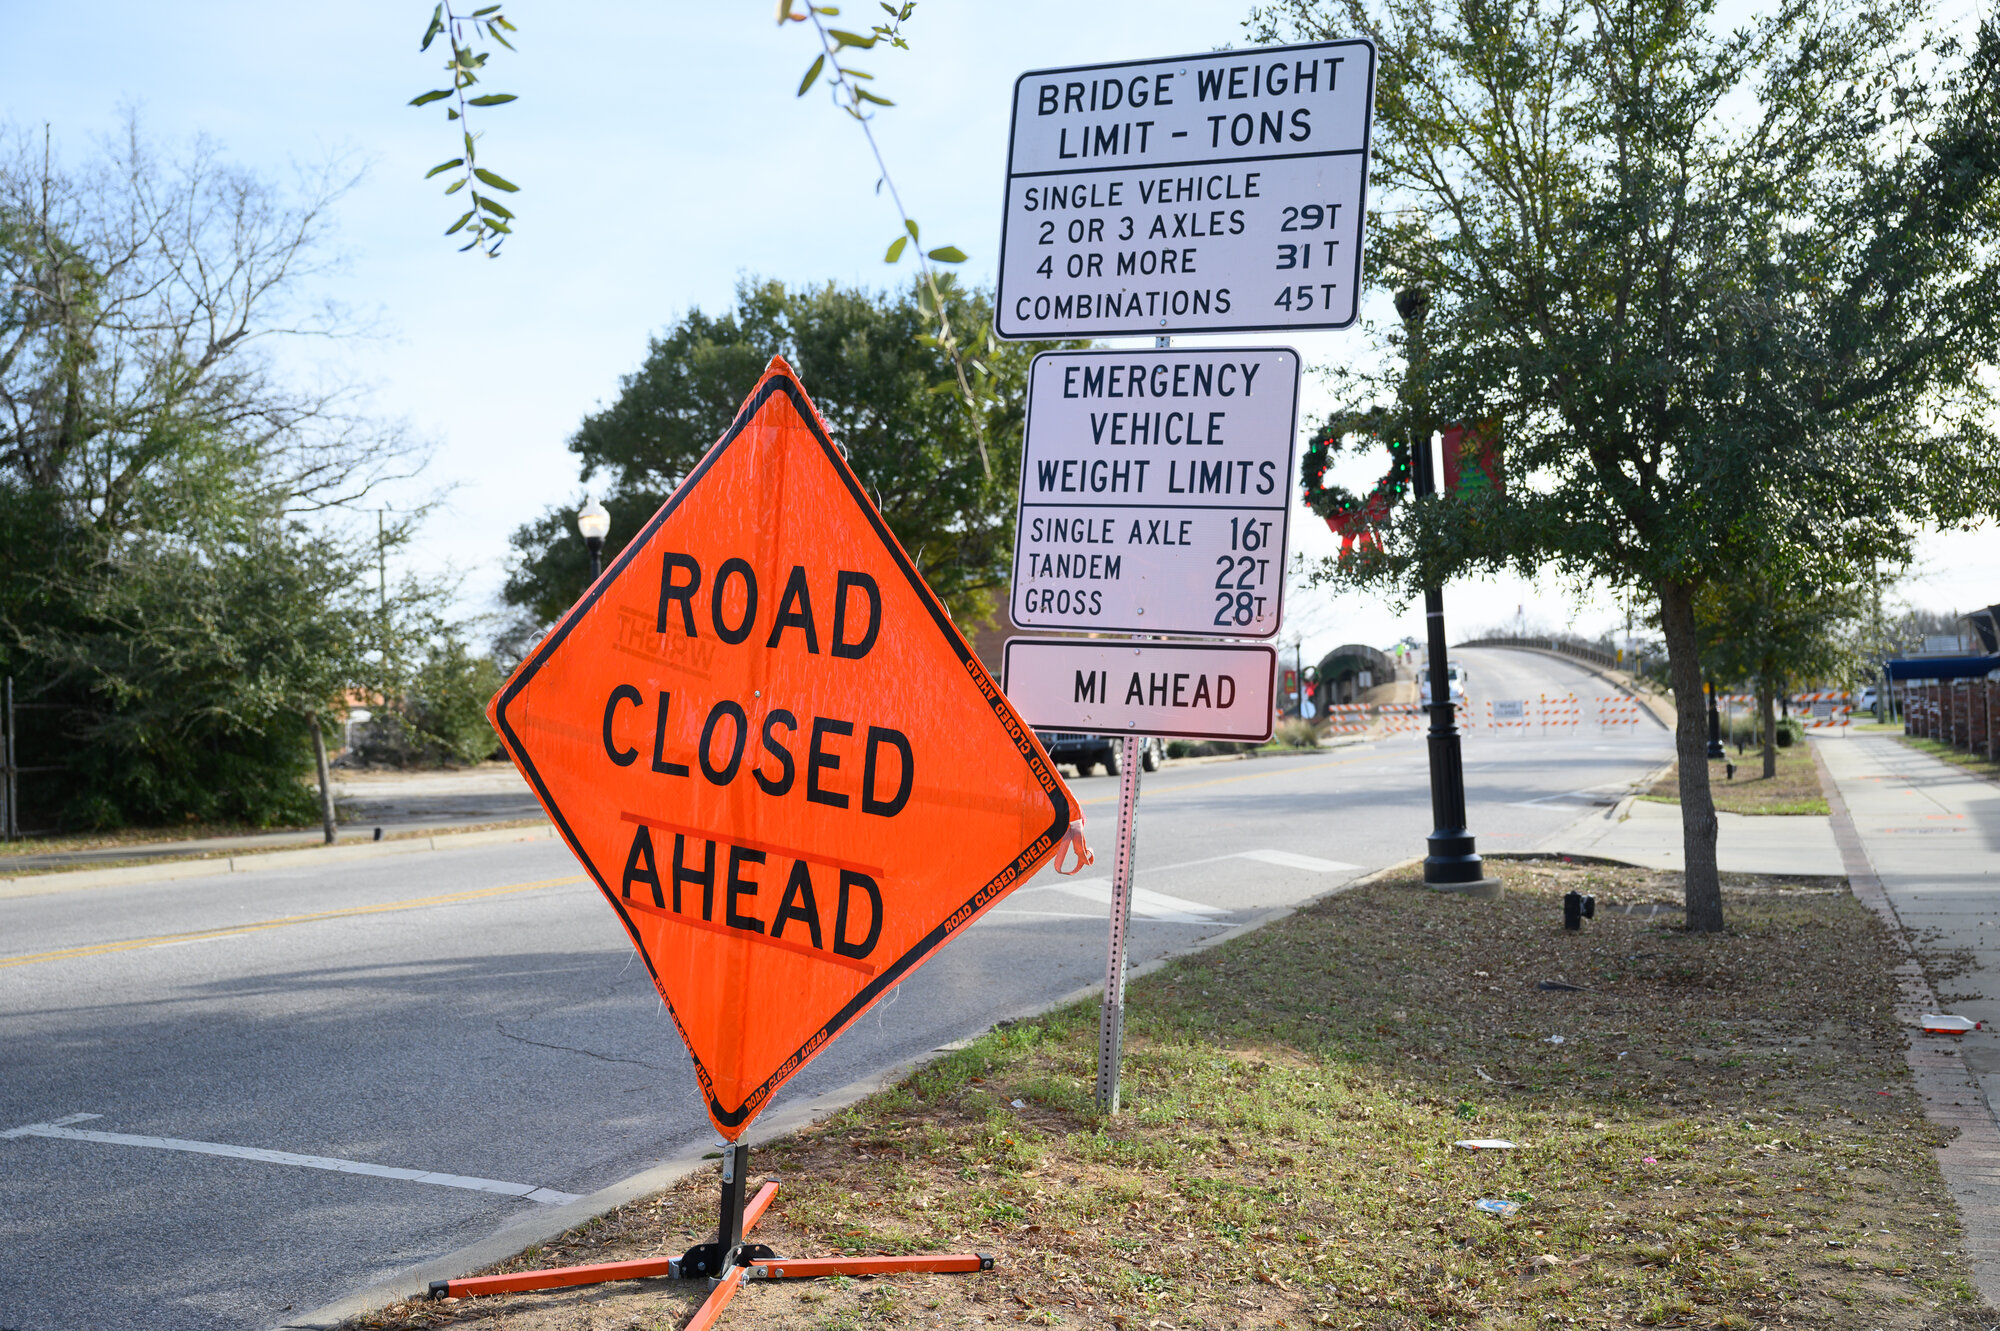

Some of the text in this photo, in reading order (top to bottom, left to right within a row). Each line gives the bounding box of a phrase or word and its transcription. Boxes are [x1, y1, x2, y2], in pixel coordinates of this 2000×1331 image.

[1038, 57, 1344, 116] BRIDGE WEIGHT
[1060, 121, 1154, 159] LIMIT
[1208, 109, 1310, 147] TONS
[1024, 173, 1260, 211] SINGLE VEHICLE
[1039, 221, 1054, 244] 2
[1069, 219, 1104, 243] OR
[1119, 217, 1133, 240] 3
[1149, 210, 1244, 239] AXLES
[1037, 256, 1052, 279] 4
[1068, 254, 1103, 278] OR
[1117, 249, 1196, 276] MORE
[1016, 289, 1230, 320] COMBINATIONS
[1064, 364, 1260, 398] EMERGENCY
[1091, 412, 1225, 445] VEHICLE
[1038, 460, 1275, 494] WEIGHT LIMITS
[1031, 518, 1114, 543] SINGLE
[1129, 520, 1192, 545] AXLE
[1030, 554, 1120, 579] TANDEM
[657, 552, 881, 659] ROAD
[1026, 589, 1102, 615] GROSS
[1075, 670, 1235, 708] MI AHEAD
[965, 659, 1056, 794] ROAD CLOSED AHEAD
[603, 685, 913, 817] CLOSED
[621, 825, 883, 960] AHEAD
[944, 835, 1052, 933] ROAD CLOSED AHEAD
[744, 1028, 828, 1112] ROAD CLOSED AHEAD
